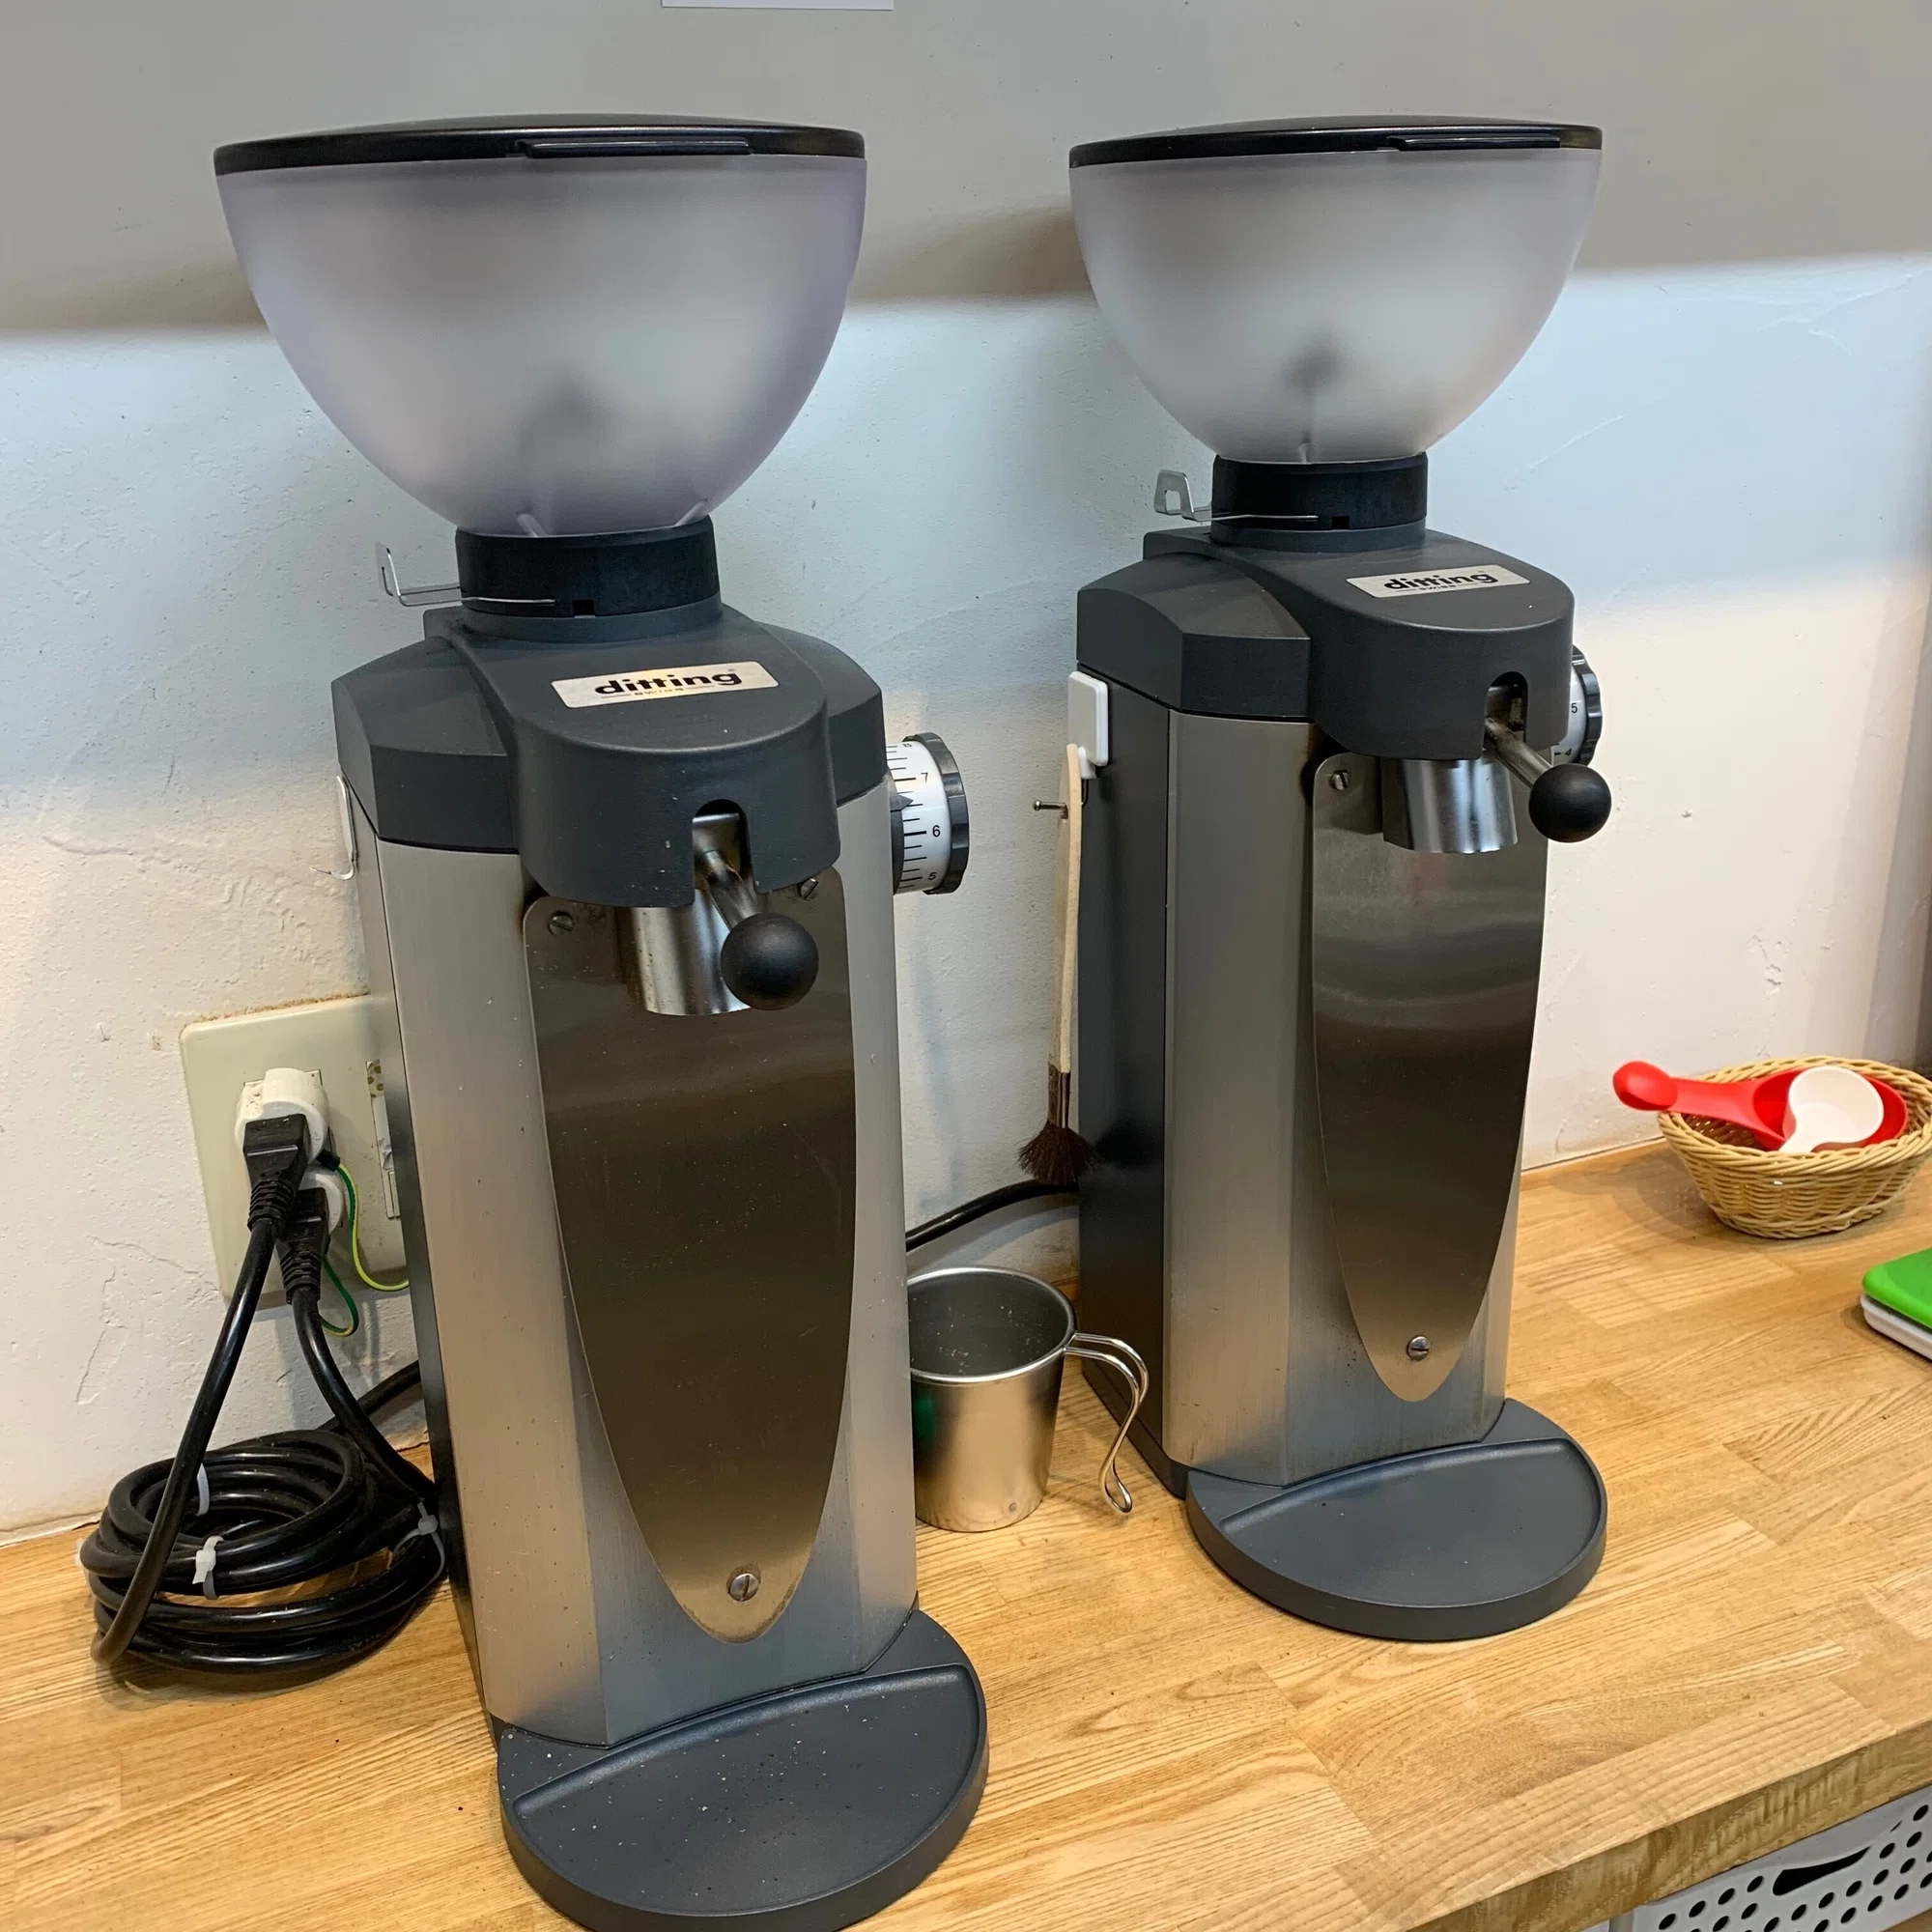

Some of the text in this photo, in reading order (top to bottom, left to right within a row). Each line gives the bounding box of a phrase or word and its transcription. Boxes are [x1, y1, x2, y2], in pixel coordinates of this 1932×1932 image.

[1384, 574, 1498, 589] ditting
[595, 672, 743, 695] ditting
[1571, 703, 1577, 713] 5
[921, 772, 928, 783] 7
[932, 824, 941, 838] 6
[928, 871, 937, 881] 5
